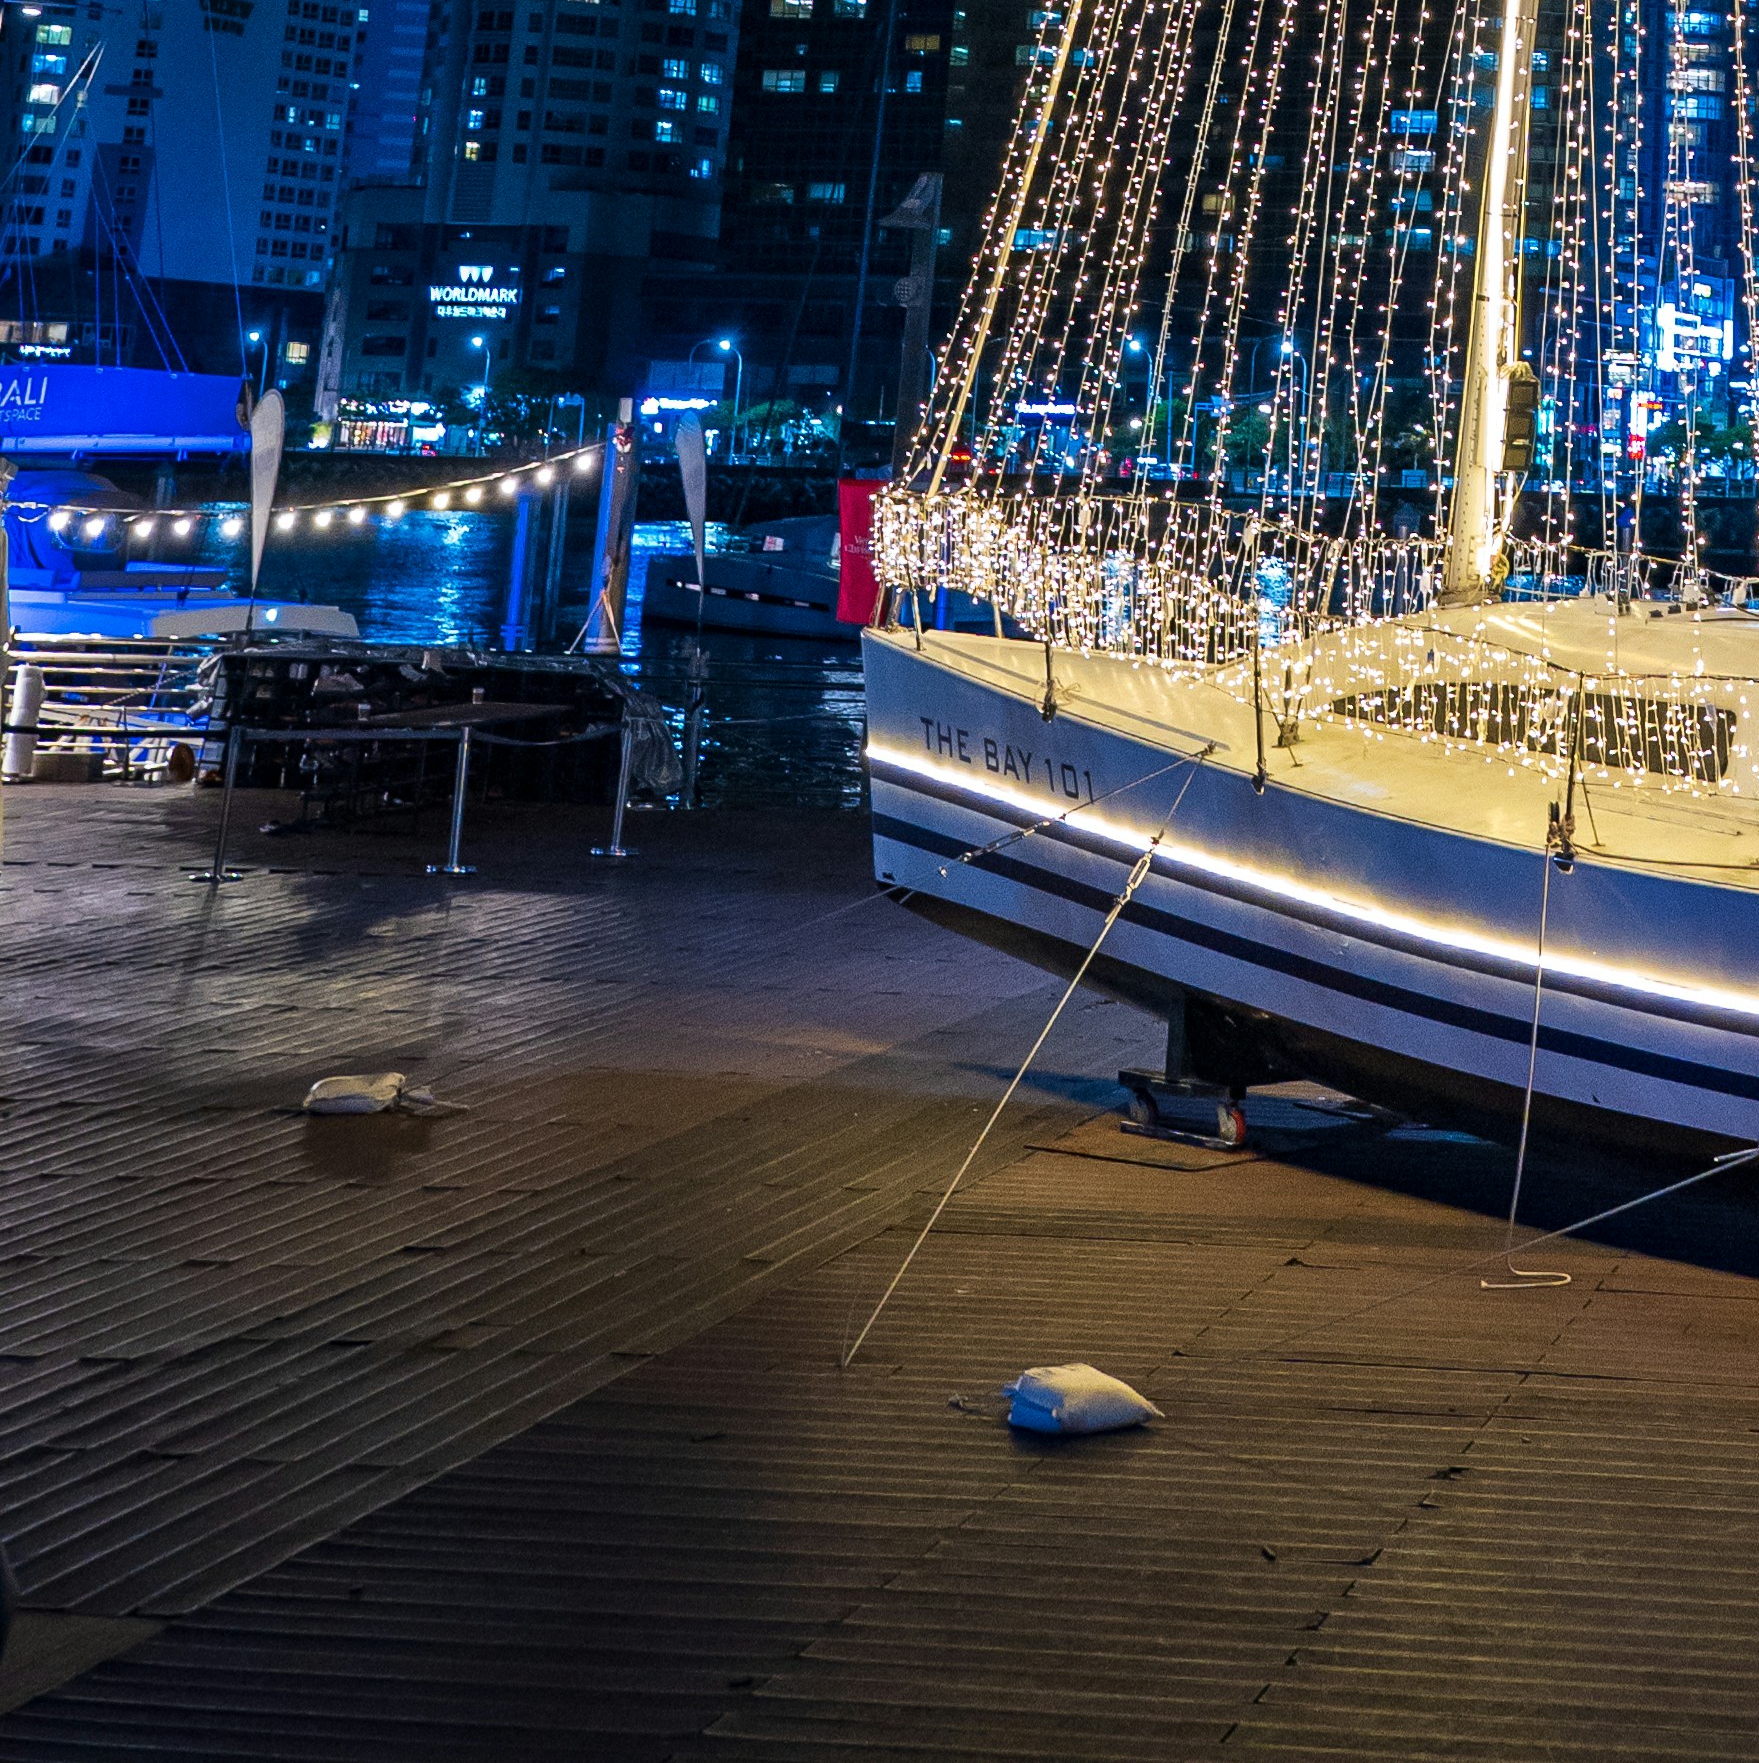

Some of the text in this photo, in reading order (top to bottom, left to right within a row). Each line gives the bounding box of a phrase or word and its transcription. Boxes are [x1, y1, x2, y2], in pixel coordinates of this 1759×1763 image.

[430, 286, 518, 304] WORLDMARK
[920, 716, 1094, 804] THE BAY 101
